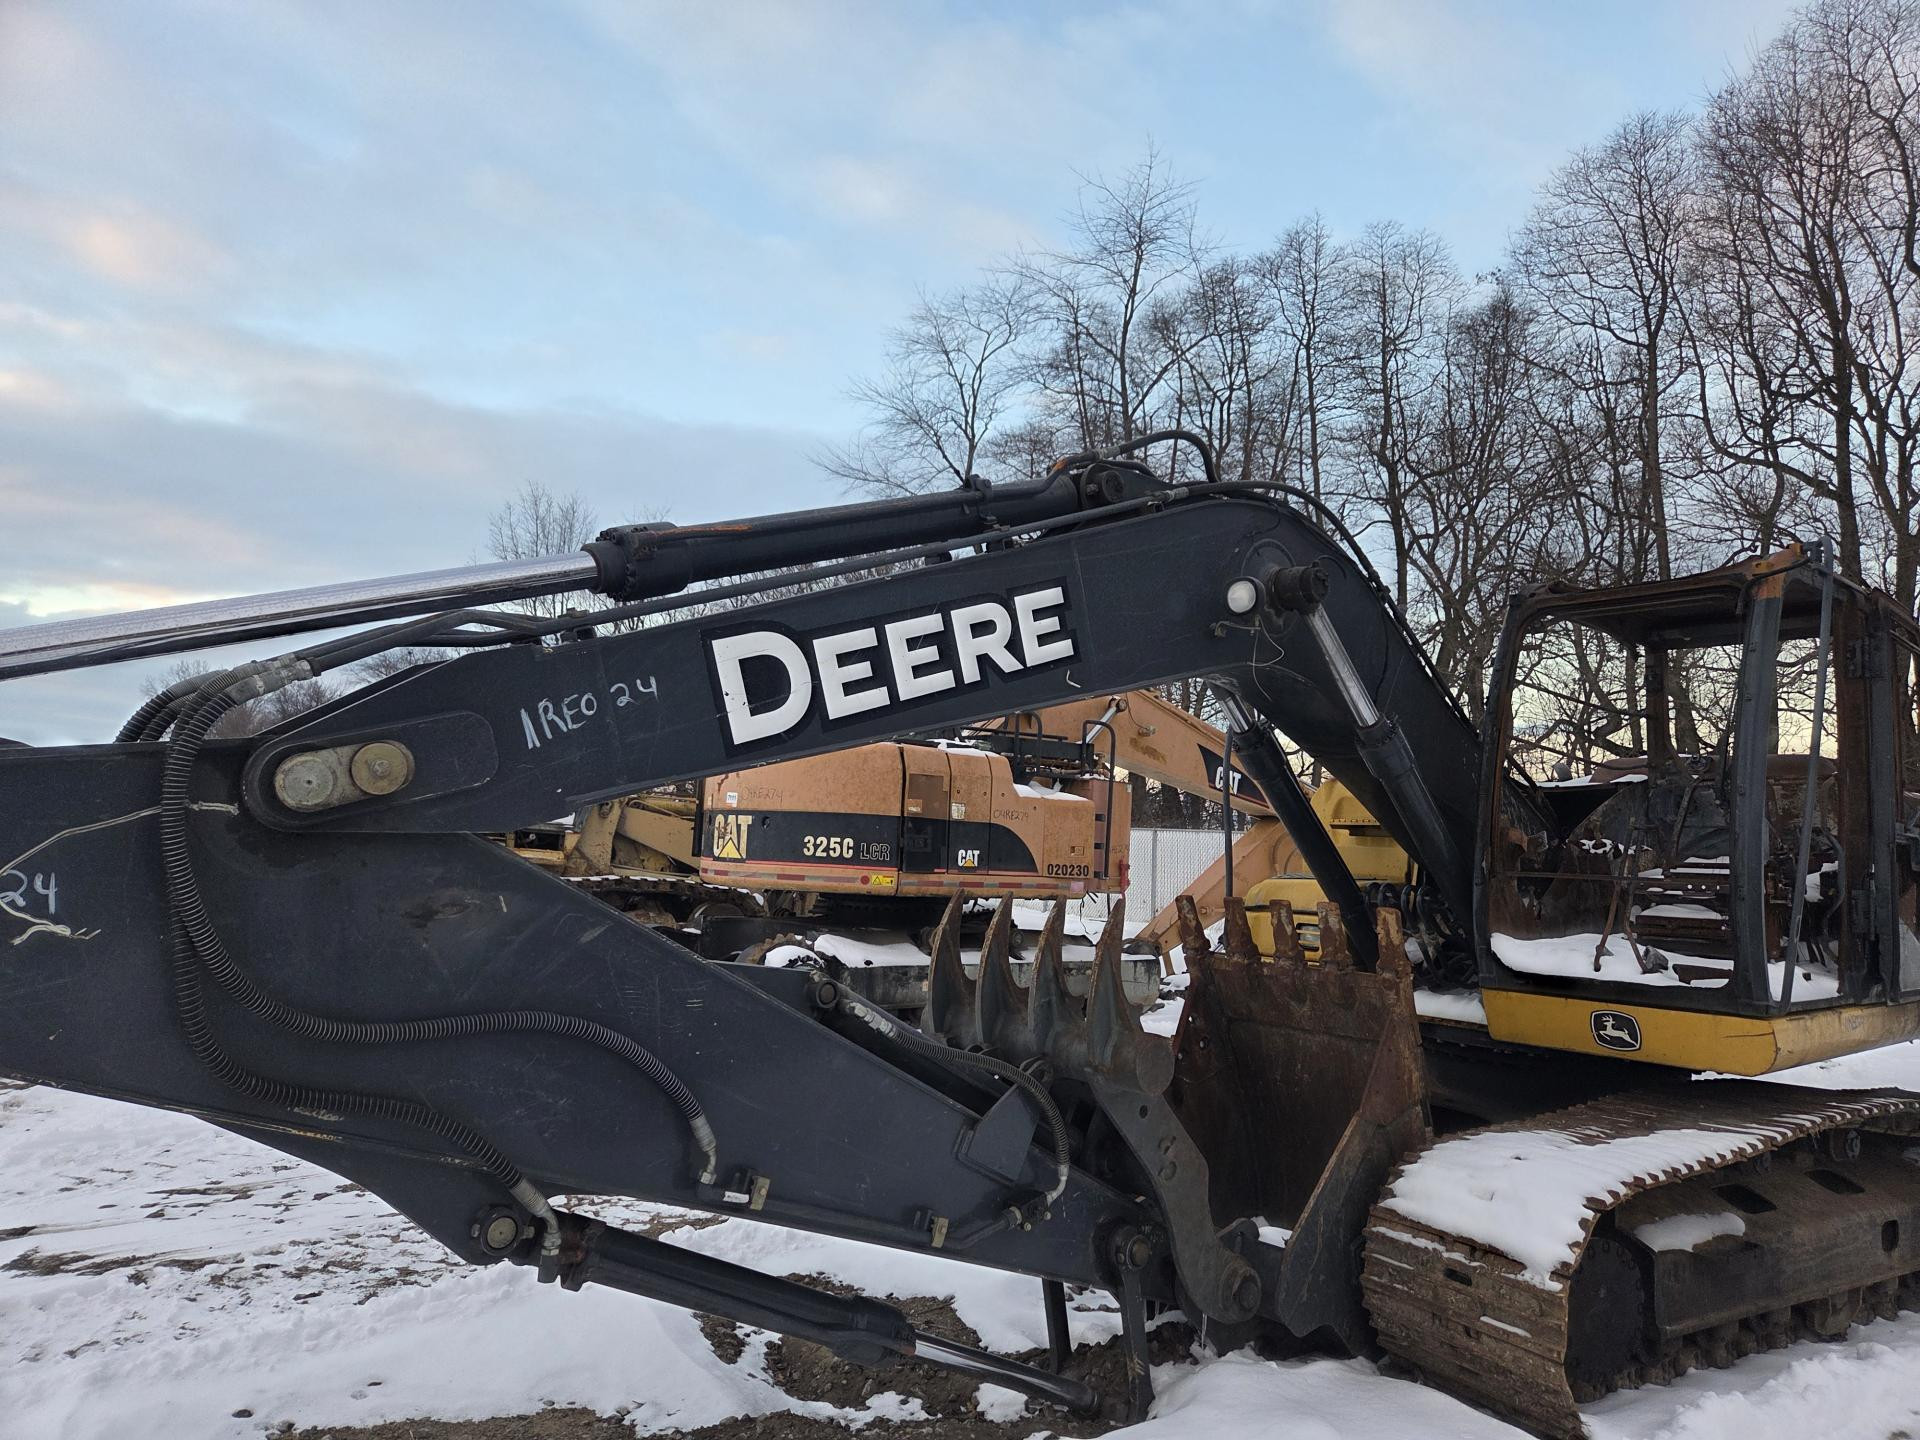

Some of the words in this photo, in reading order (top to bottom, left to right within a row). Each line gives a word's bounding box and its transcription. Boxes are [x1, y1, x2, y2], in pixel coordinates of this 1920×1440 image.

[712, 586, 1074, 745] DEERE
[713, 813, 752, 859] CAT
[803, 835, 854, 859] 325C
[860, 842, 891, 861] LCR
[957, 849, 980, 867] CAT
[1047, 863, 1089, 877] 020230
